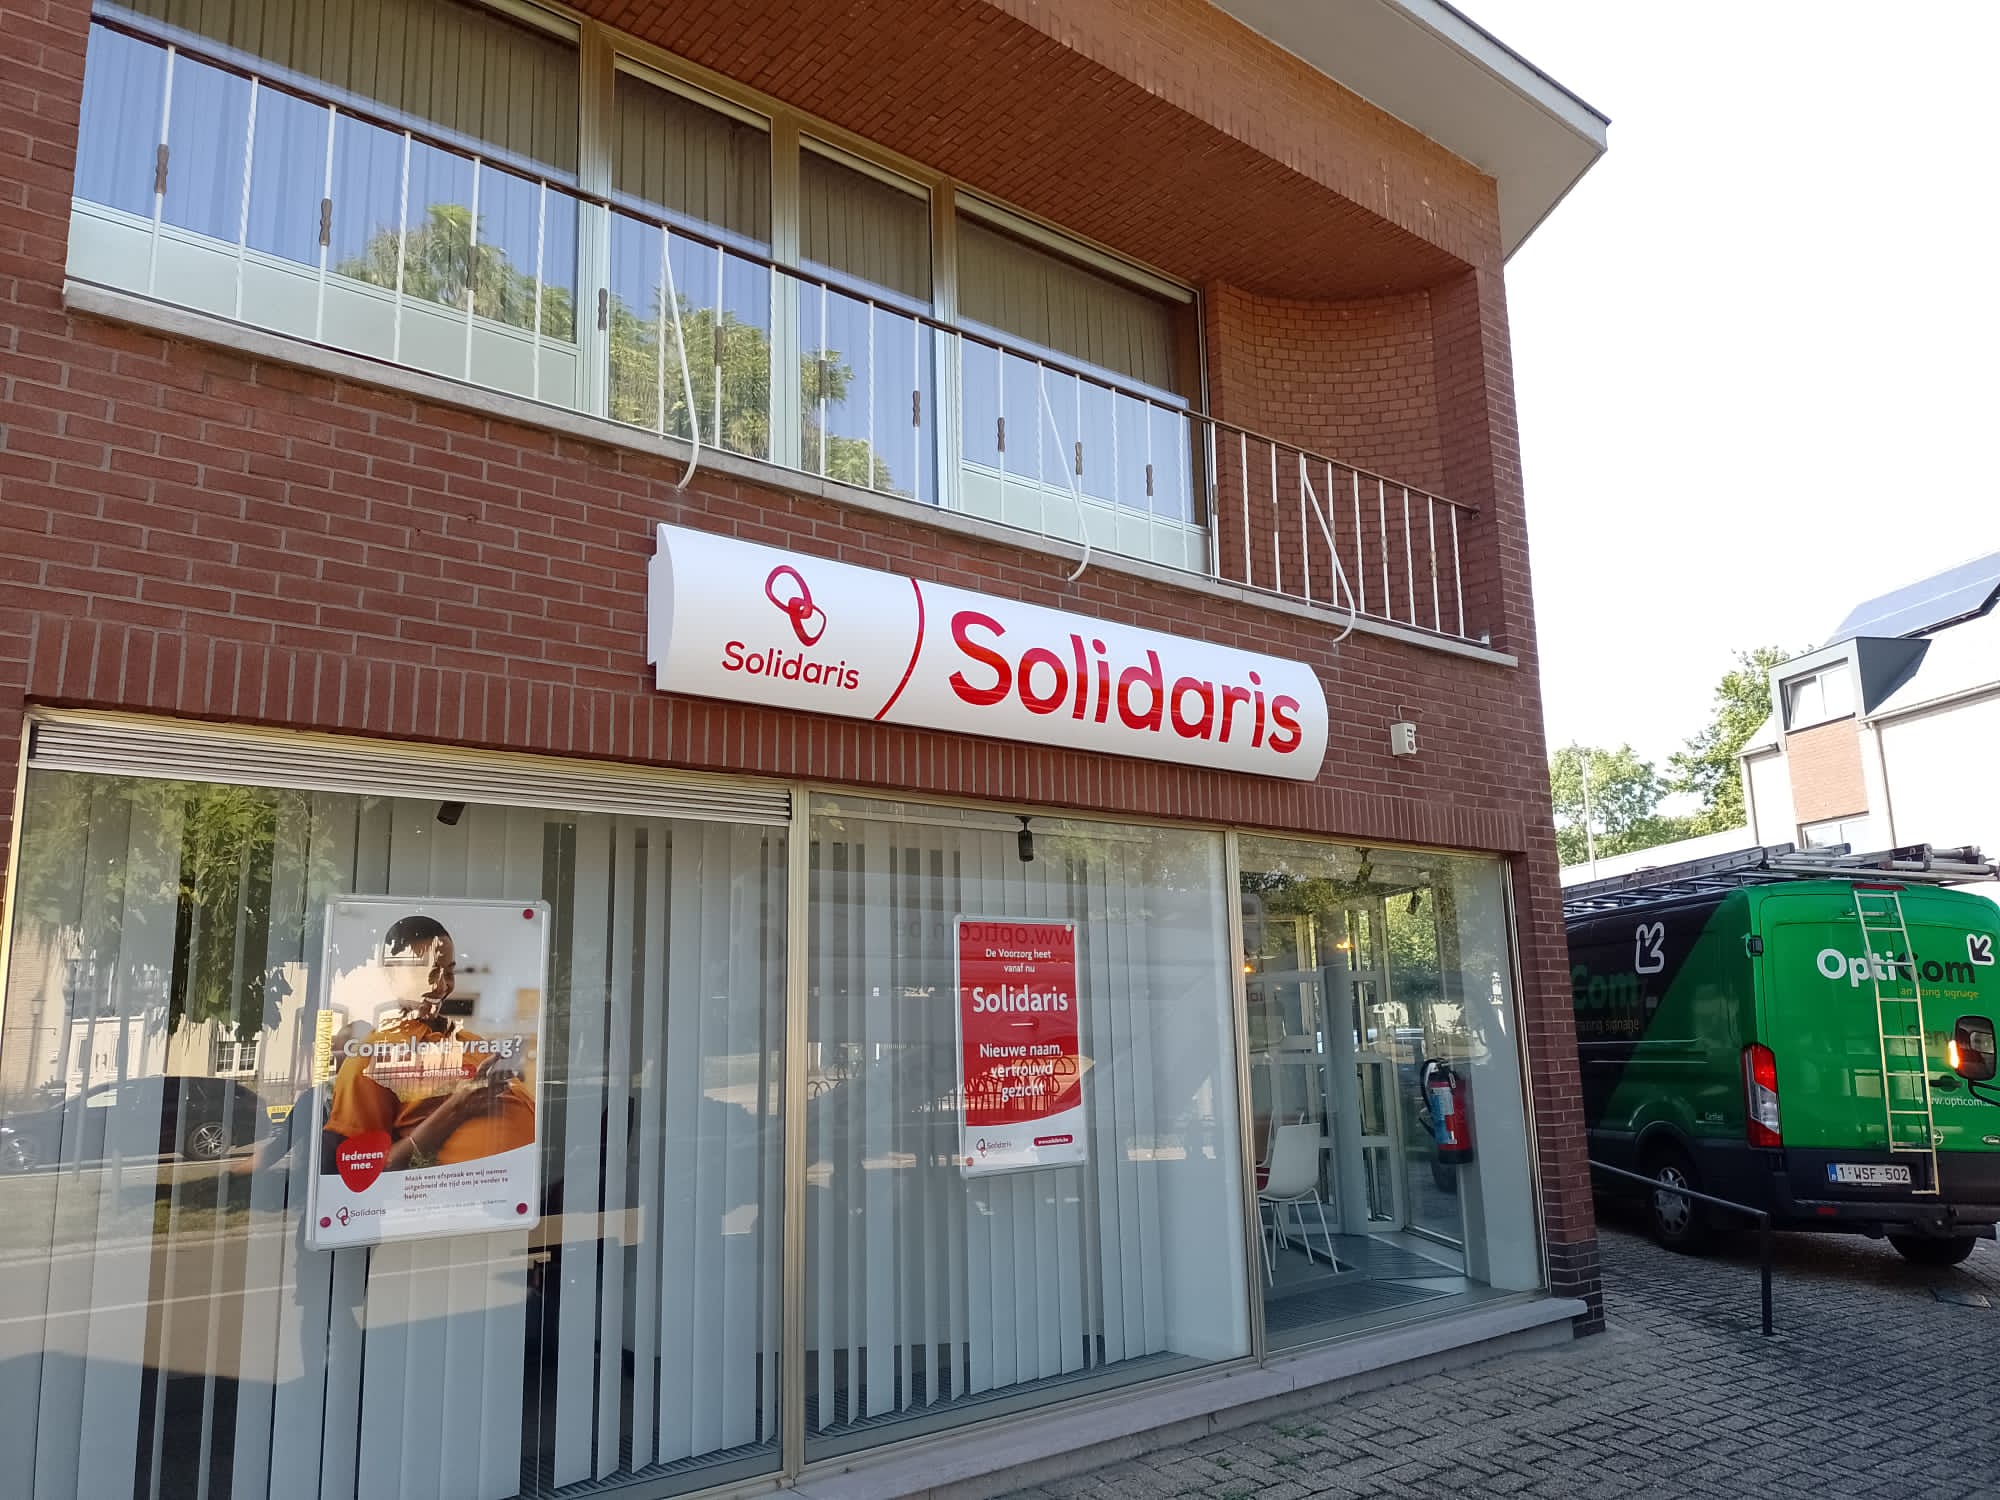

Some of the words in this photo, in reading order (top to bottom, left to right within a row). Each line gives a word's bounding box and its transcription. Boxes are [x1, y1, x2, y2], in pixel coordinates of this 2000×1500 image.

[721, 640, 860, 691] Solidaris
[948, 610, 1303, 755] Solidaris
[985, 948, 997, 958] De
[998, 948, 1033, 961] Voorzorg
[1033, 948, 1052, 959] heet
[1003, 962, 1024, 973] vanaf
[1025, 963, 1036, 973] nu
[1816, 948, 1976, 988] OptiCom
[972, 984, 1069, 1012] Solidaris
[462, 1035, 523, 1058] vraag?
[979, 1043, 1027, 1058] Nieuwe
[1029, 1044, 1064, 1057] naam,
[990, 1059, 1054, 1078] vertrouwd
[1001, 1081, 1045, 1102] gezicht
[341, 1150, 384, 1162] Iedereen
[350, 1161, 375, 1171] mee.
[350, 1208, 386, 1217] Solidaris
